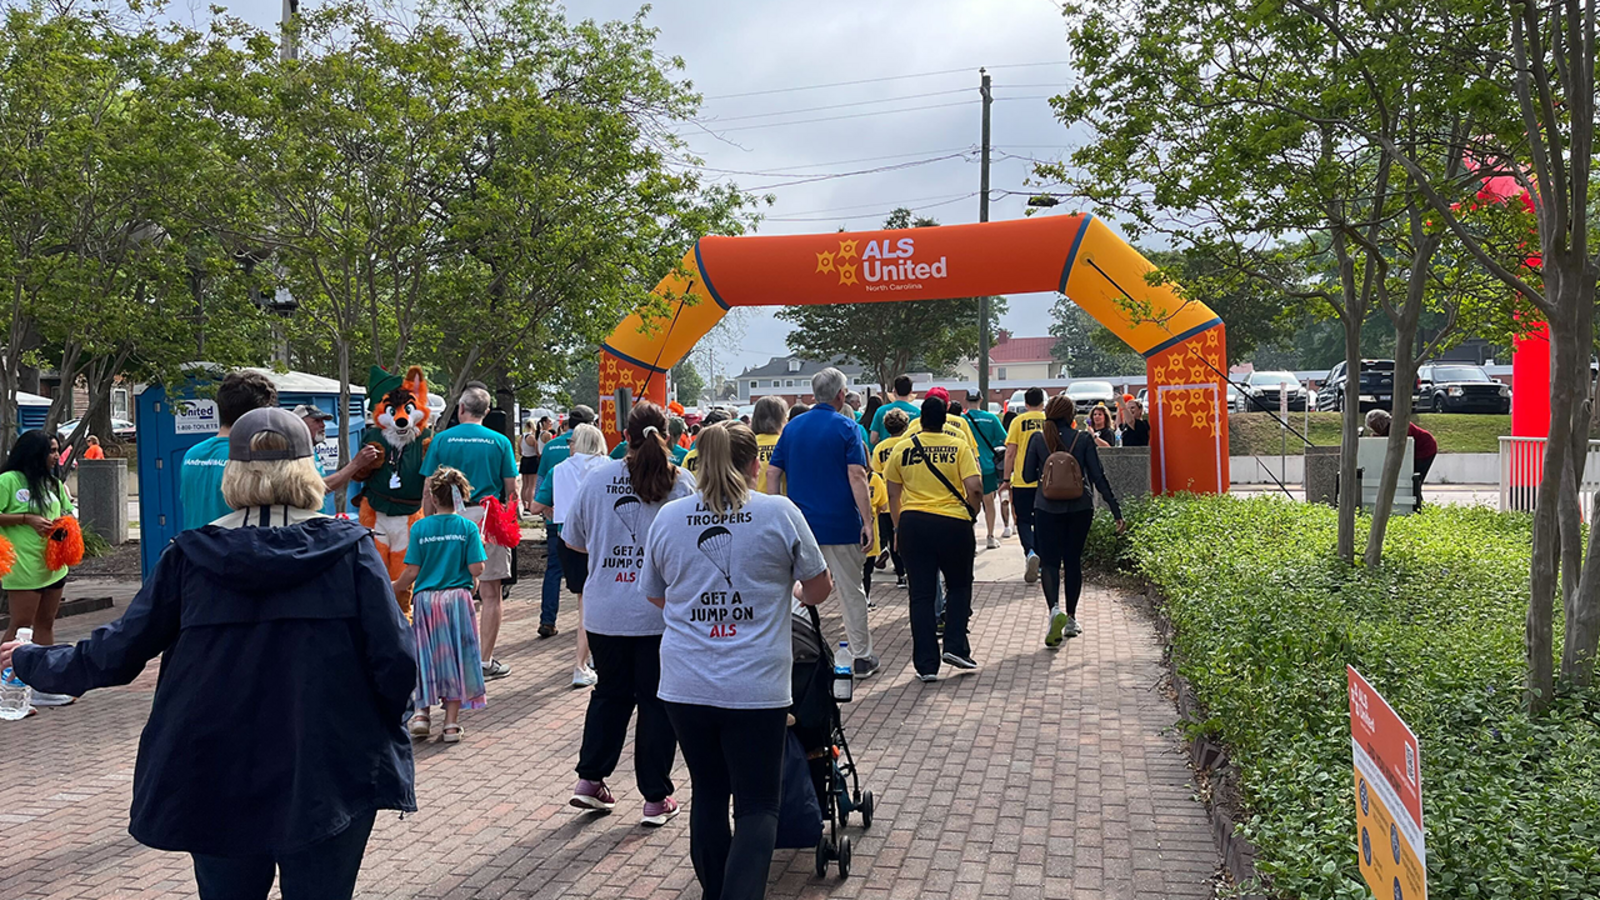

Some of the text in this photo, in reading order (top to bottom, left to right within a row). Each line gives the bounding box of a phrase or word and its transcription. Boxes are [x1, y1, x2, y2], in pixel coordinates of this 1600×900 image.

[862, 238, 914, 260] ALS
[863, 256, 947, 282] United
[866, 283, 922, 292] North Carolina
[921, 453, 956, 464] NEWS
[686, 512, 752, 526] TROOPERS
[613, 546, 645, 556] GET A
[602, 559, 644, 569] JUMP O
[615, 572, 636, 582] ALS
[700, 591, 742, 605] GET A
[690, 607, 754, 622] JUMP ON
[710, 624, 737, 638] ALS
